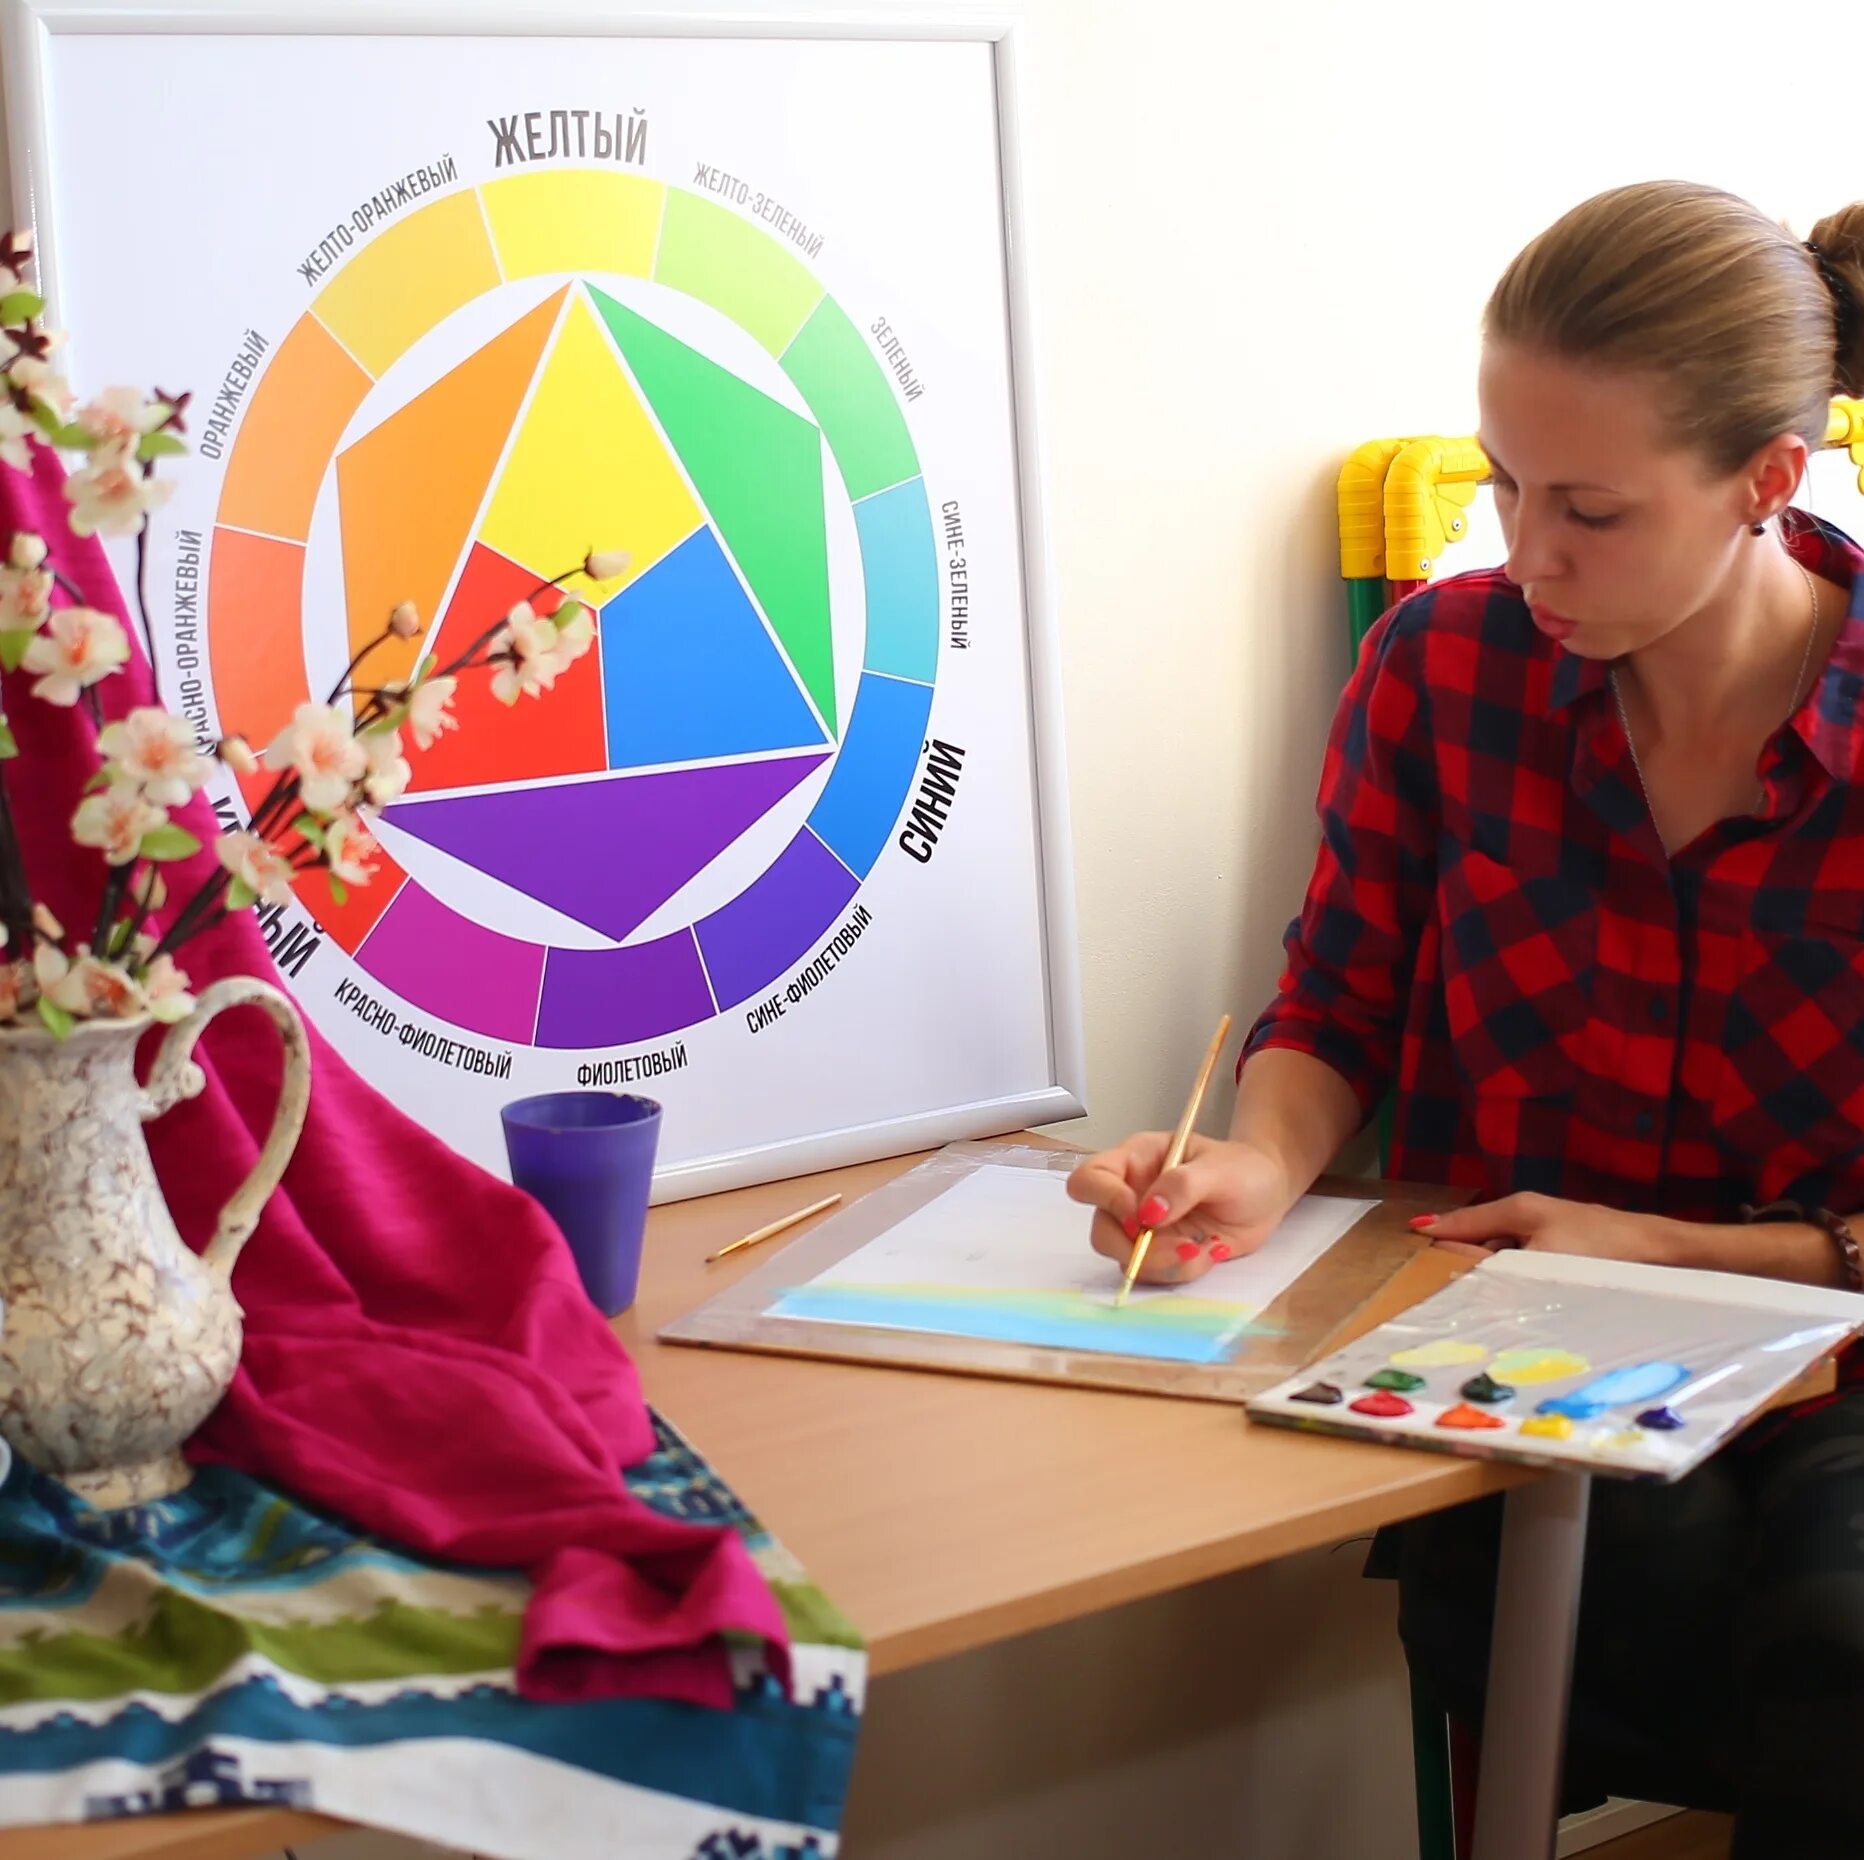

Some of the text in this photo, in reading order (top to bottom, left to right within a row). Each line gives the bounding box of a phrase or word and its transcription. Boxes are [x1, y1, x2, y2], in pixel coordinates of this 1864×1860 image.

[487, 107, 649, 167] ЖЕЛТЫЙ
[296, 153, 458, 287] ЖЕЛТО-ОРАНЖЕВЫЙ
[693, 160, 824, 260] ЖЕЛТО-ЗЕЛЕНЫЙ
[199, 328, 270, 461] ОРАНЖЕВЫЙ
[869, 315, 926, 403] ЗЕЛЕНЫЙ
[941, 499, 971, 651] СИНЕ-ЗЕЛЕНЫЙ
[898, 738, 967, 865] СИНИЙ
[745, 903, 874, 1035] СИНЕ-ФИОЛЕТОВЫЙ
[333, 976, 514, 1082] КРАСНО-ФИОЛЕТОВЫЙ
[576, 1041, 689, 1087] ФИОЛЕТОВЫЙ
